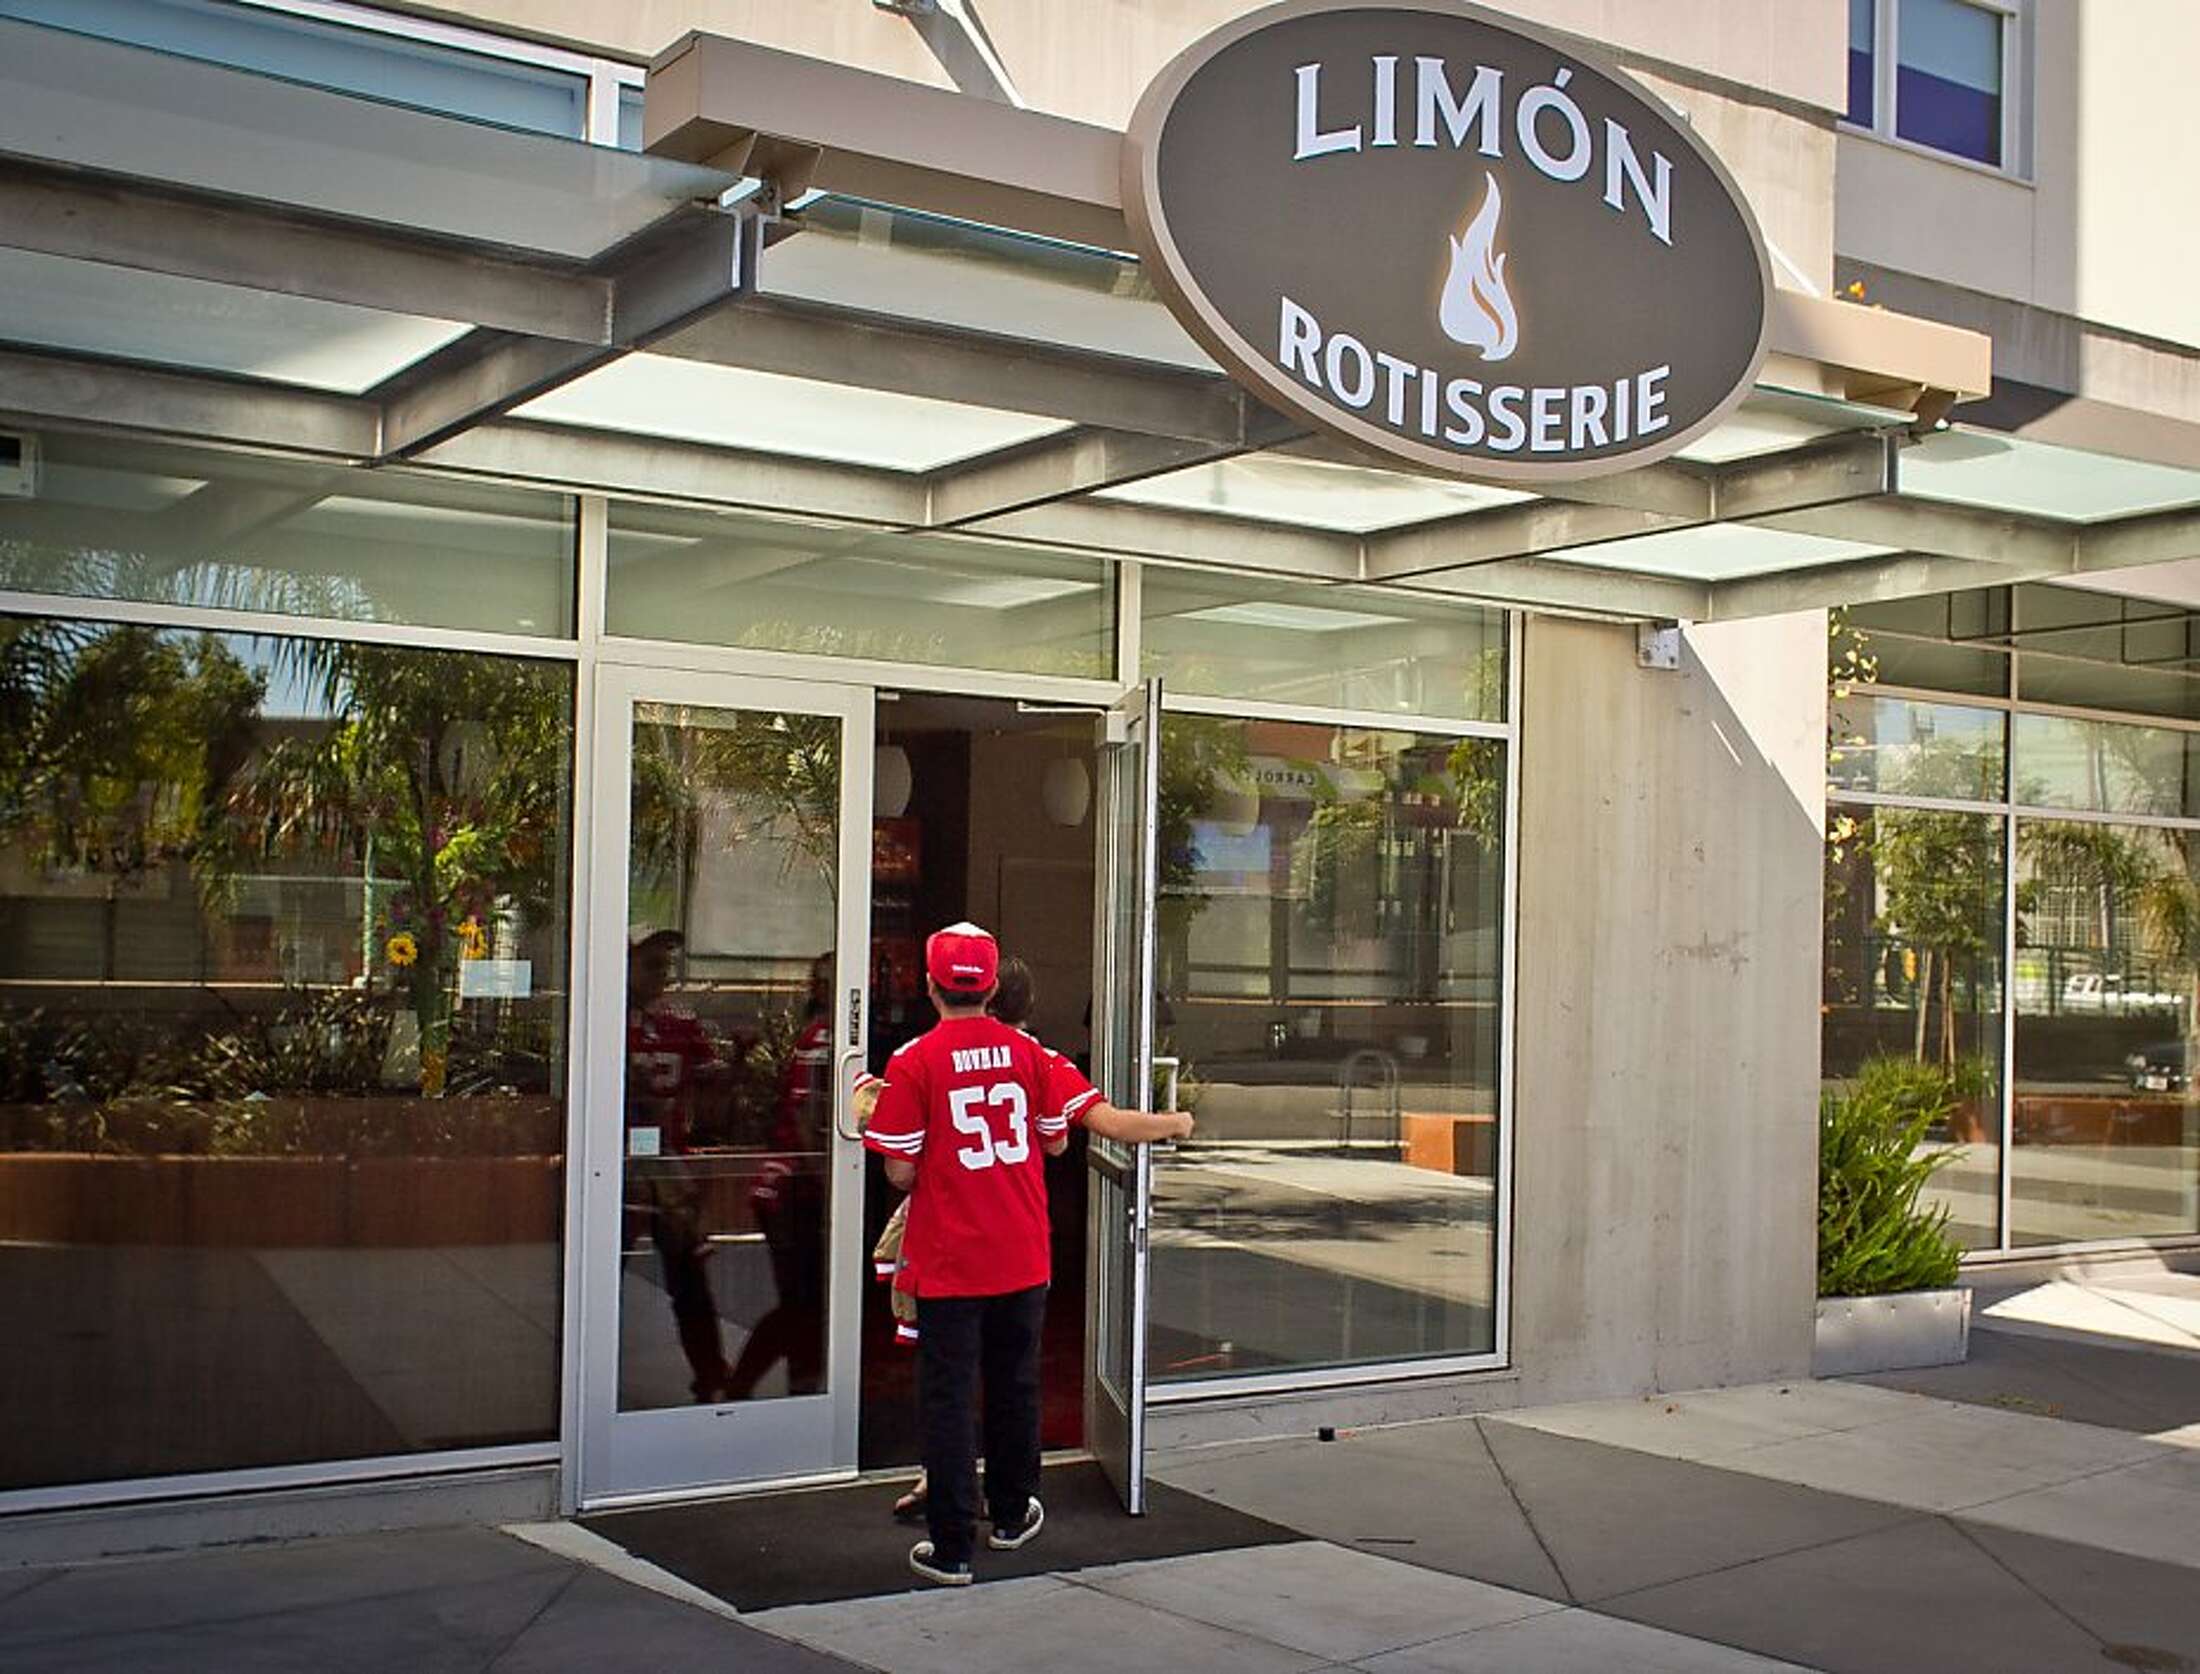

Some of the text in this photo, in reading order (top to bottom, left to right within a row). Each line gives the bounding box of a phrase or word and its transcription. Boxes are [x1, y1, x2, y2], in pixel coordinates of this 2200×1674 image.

[1294, 55, 1673, 246] LIMÓN
[1280, 296, 1669, 453] ROTISSERIE
[948, 1082, 1029, 1170] 53
